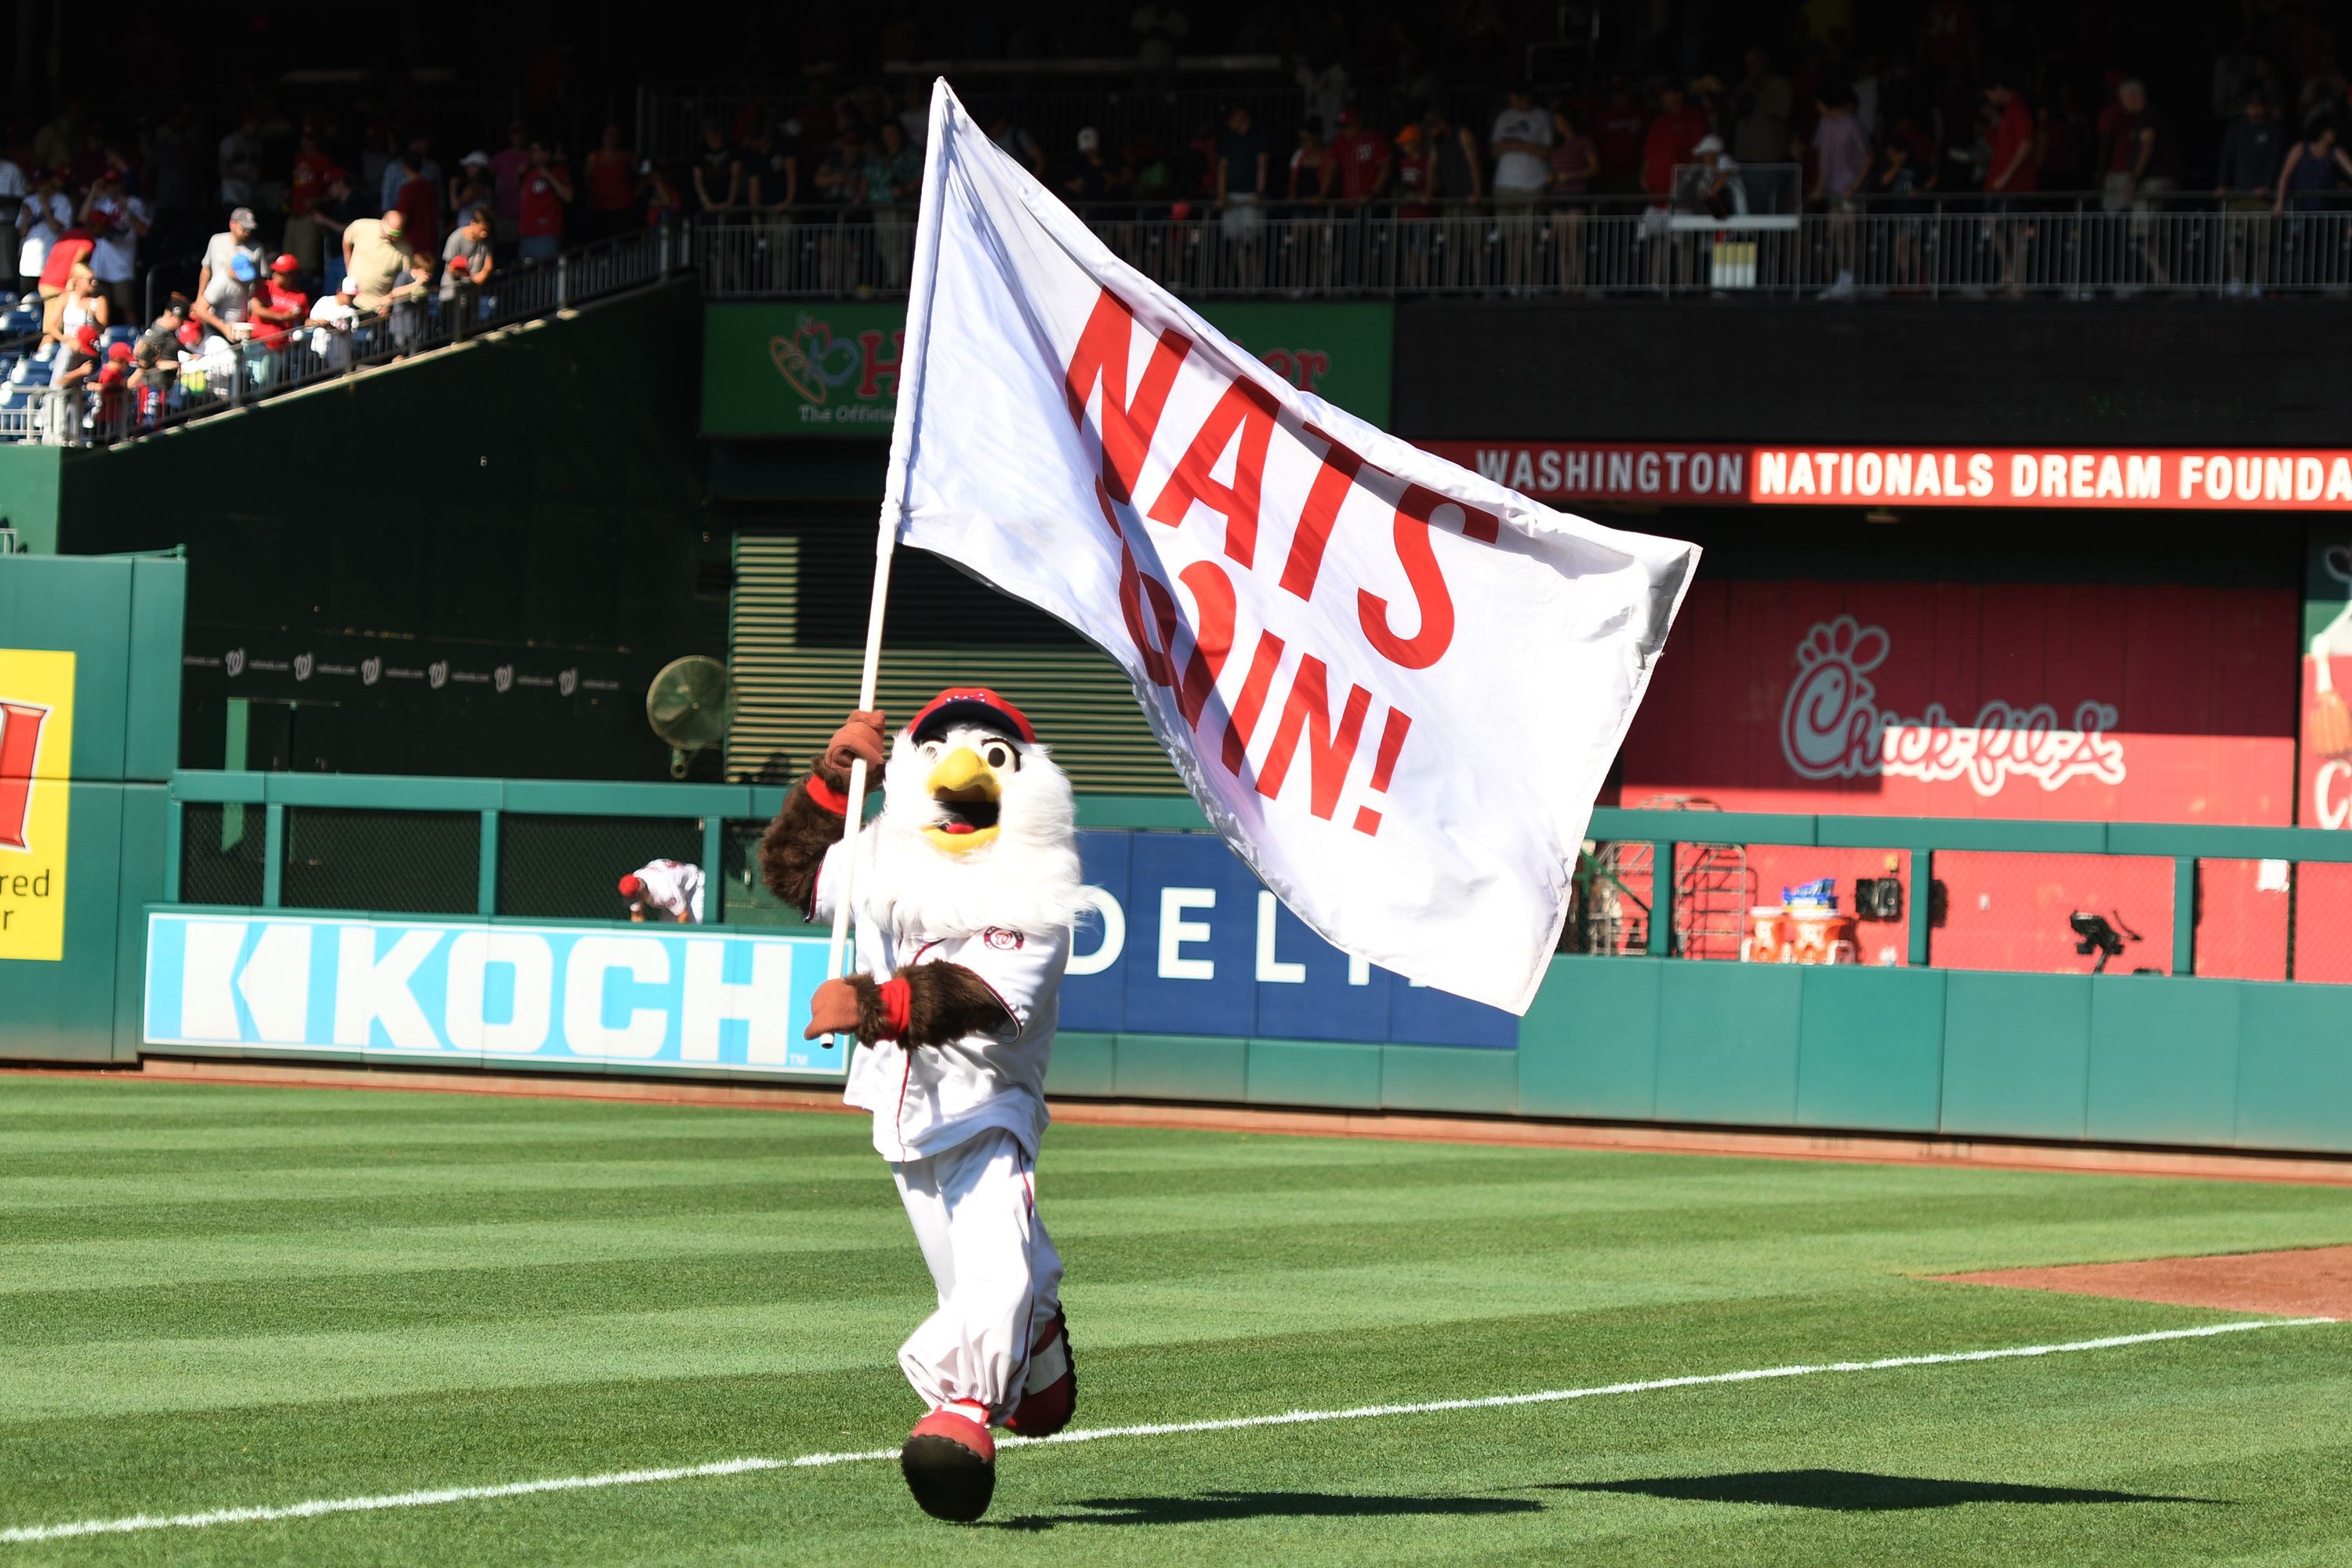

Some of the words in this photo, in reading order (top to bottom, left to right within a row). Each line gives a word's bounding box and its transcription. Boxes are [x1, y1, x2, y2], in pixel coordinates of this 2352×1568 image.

[1065, 284, 1500, 670] NATS
[1475, 449, 1744, 495] WASHINGTON
[1759, 452, 1994, 498] NATIONALS
[2009, 454, 2162, 500] DREAM
[2177, 455, 2352, 502] FOUNDA
[333, 925, 793, 1065] KOCH
[1064, 884, 1427, 988] DEL
